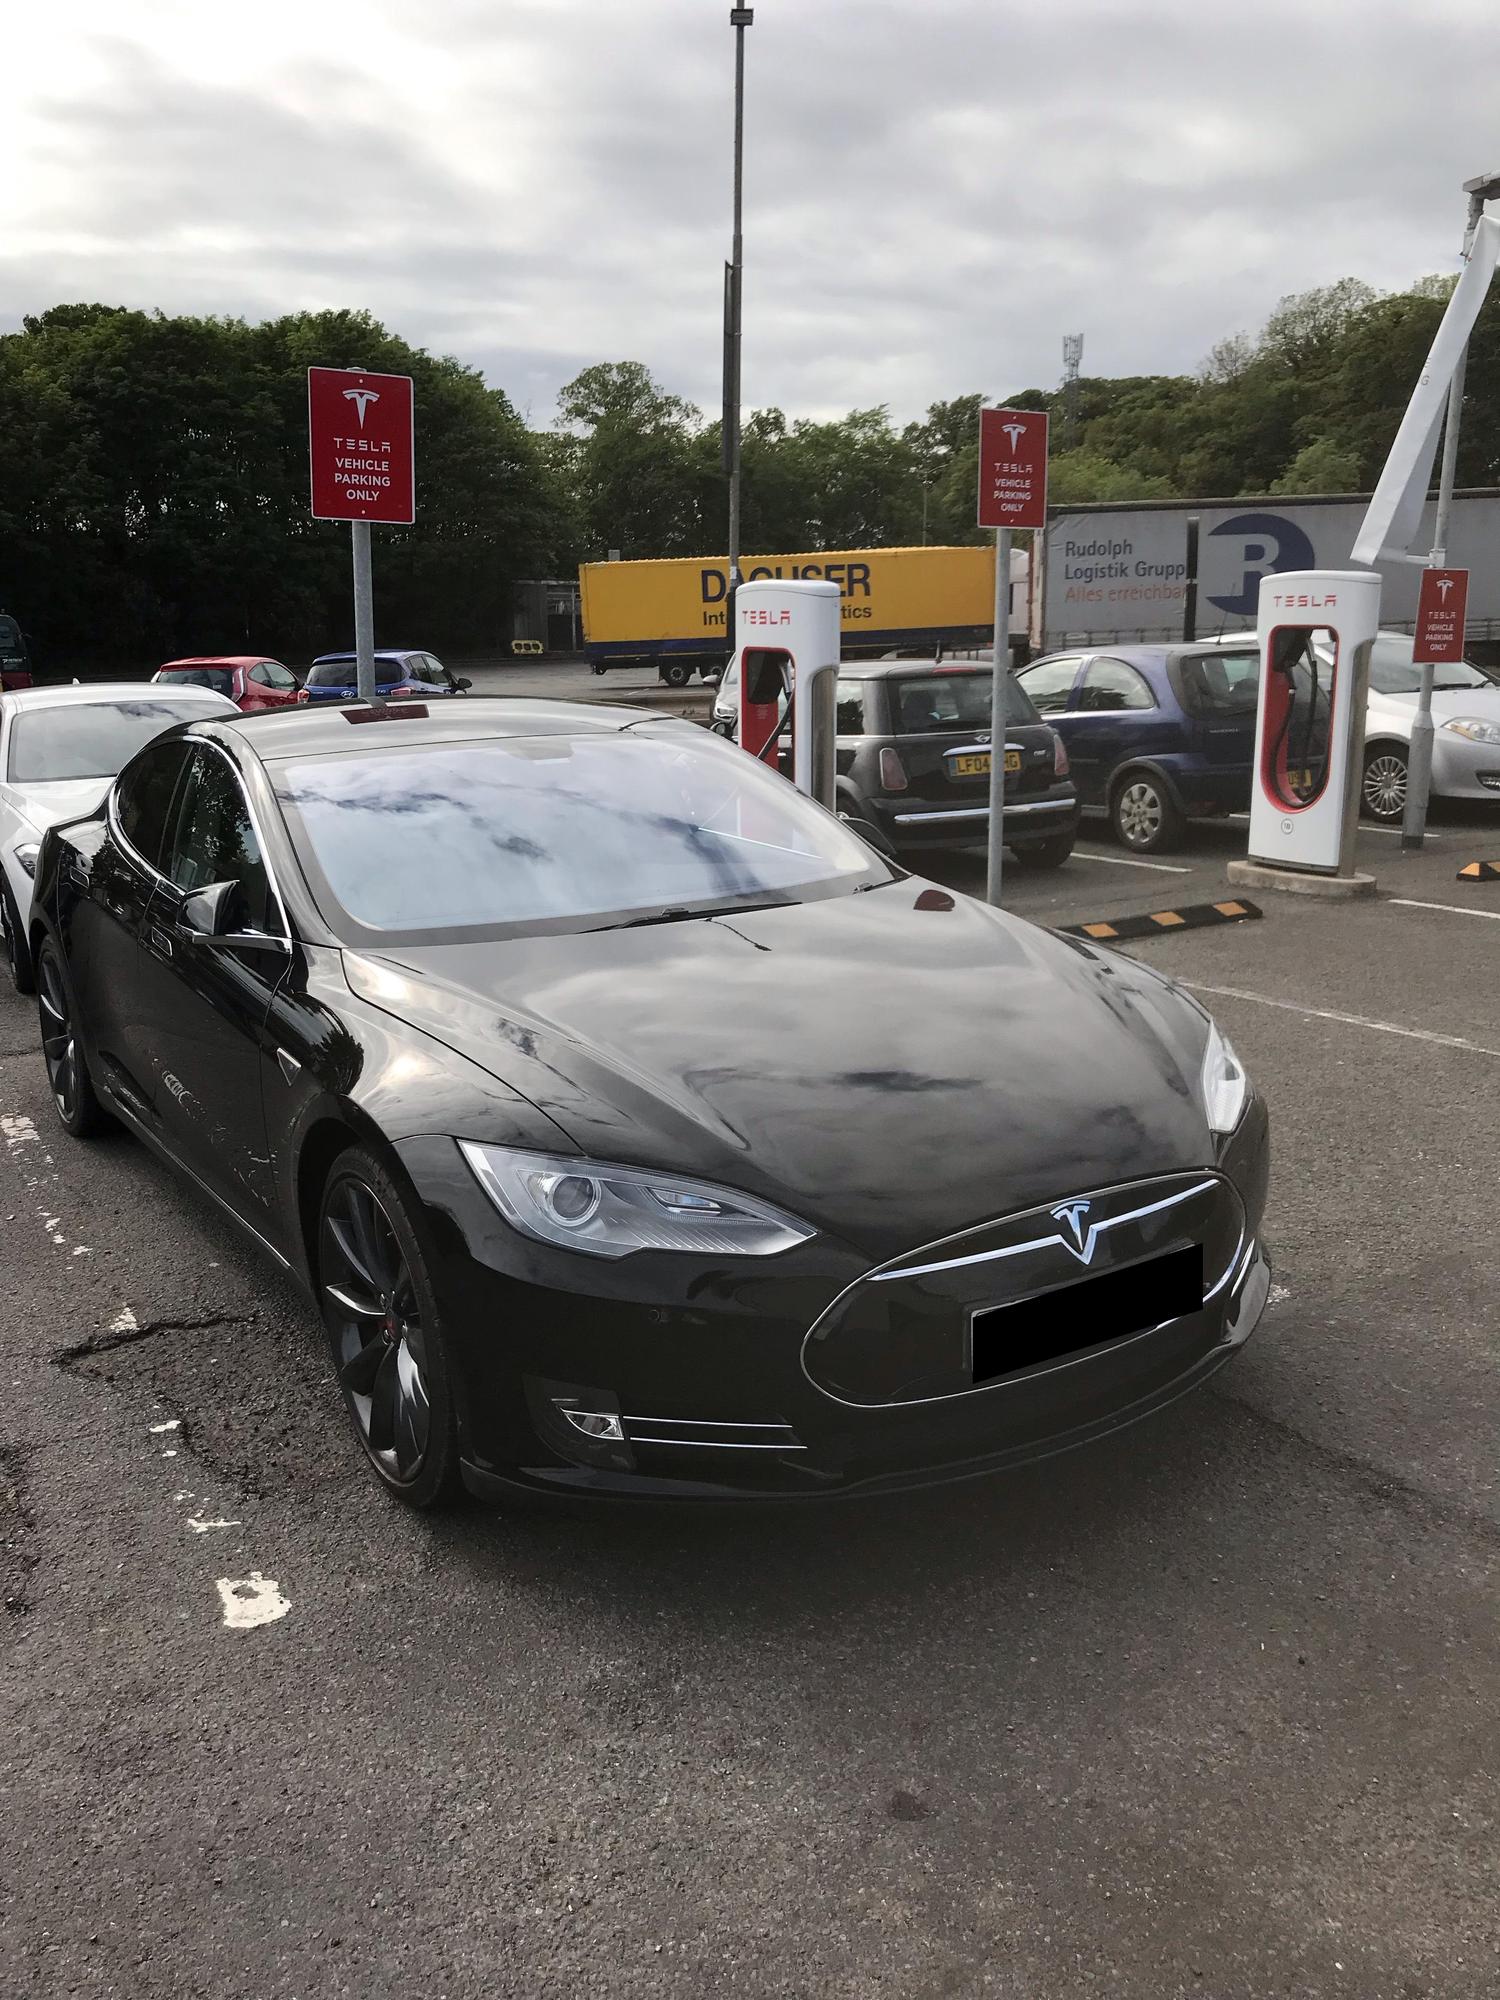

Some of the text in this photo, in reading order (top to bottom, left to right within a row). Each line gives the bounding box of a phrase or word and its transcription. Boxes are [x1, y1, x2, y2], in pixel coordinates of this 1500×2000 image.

[333, 437, 391, 453] TESLA
[335, 457, 389, 471] VEHICLE
[994, 462, 1033, 474] TESLA
[334, 473, 391, 487] PARKING
[994, 478, 1032, 488] VEHICLE
[346, 489, 380, 501] ONLY
[993, 490, 1032, 500] PARKING
[1000, 502, 1024, 512] ONLY
[1065, 539, 1133, 559] Rudolph
[1064, 560, 1185, 583] Logistik Grupp
[1065, 585, 1103, 602] Alles
[1273, 594, 1337, 607] TESLA
[742, 610, 791, 625] TESLA
[1428, 611, 1456, 619] TESLA
[1427, 623, 1454, 631] VEHICLE
[1429, 643, 1447, 651] ONLY
[957, 755, 990, 773] LF04
